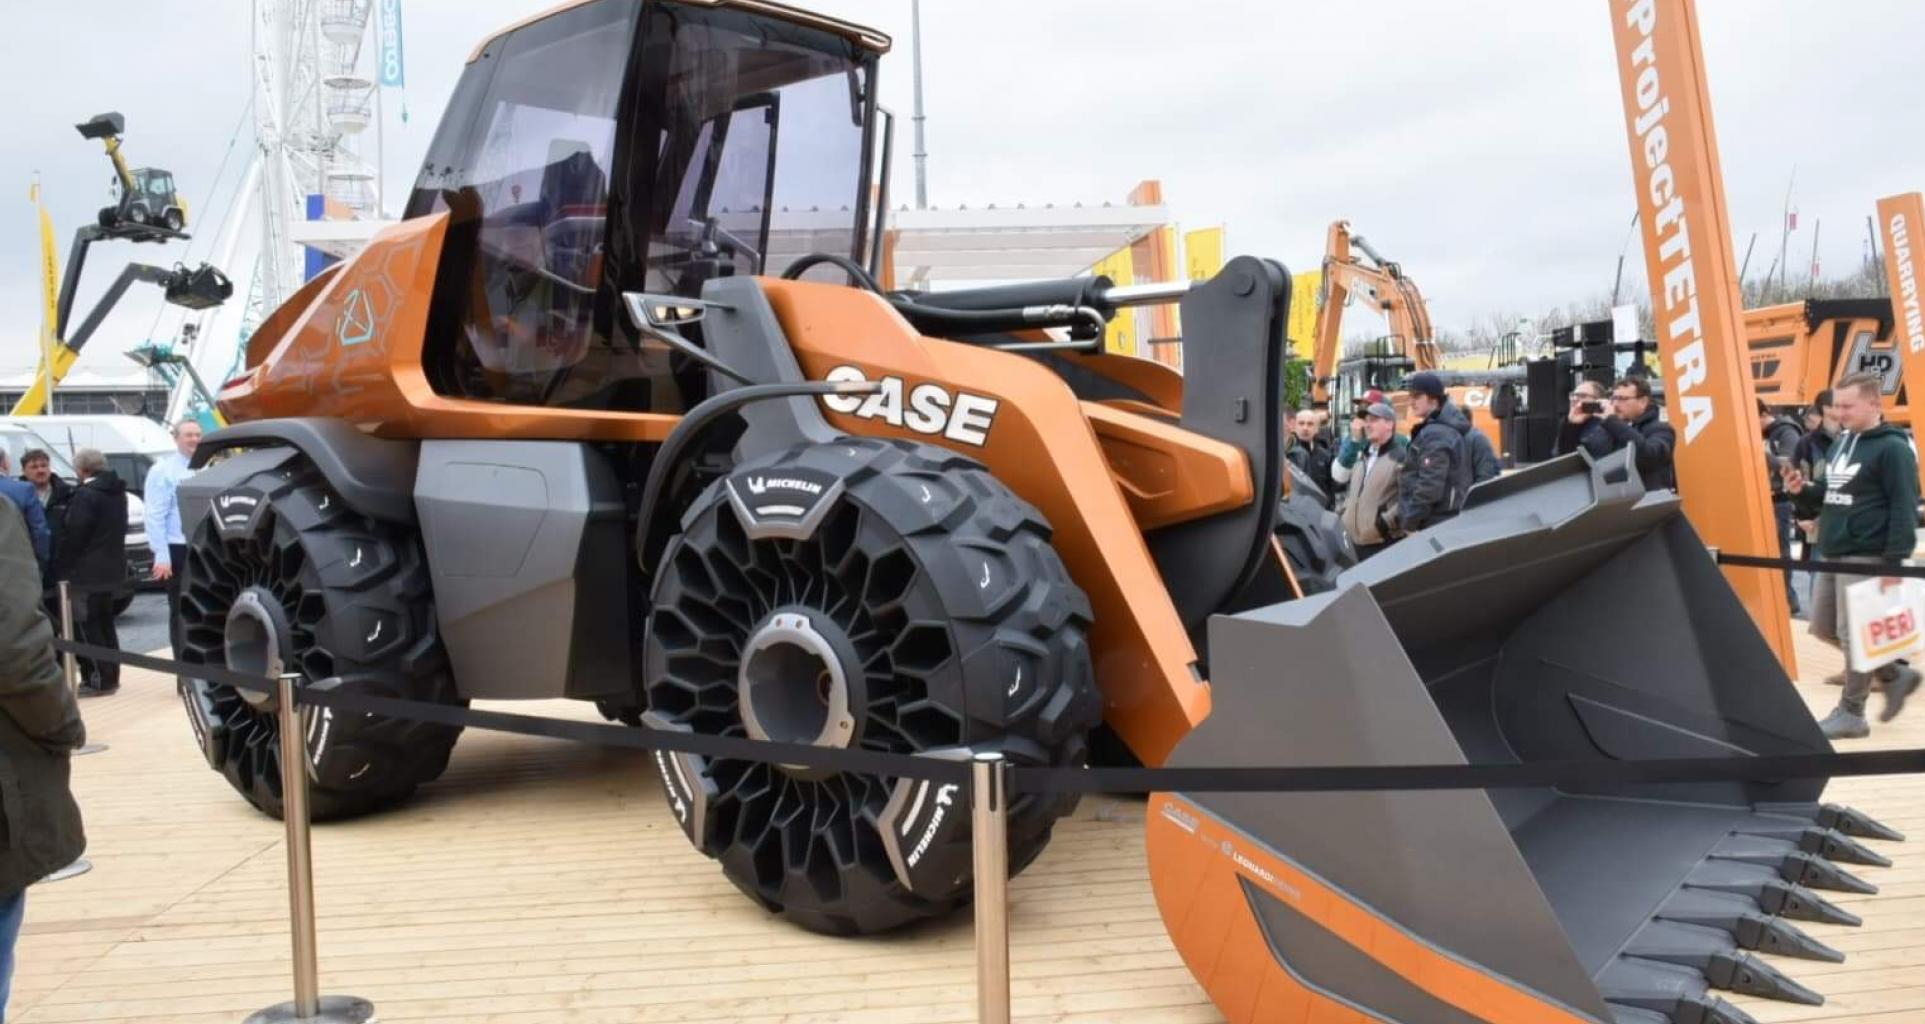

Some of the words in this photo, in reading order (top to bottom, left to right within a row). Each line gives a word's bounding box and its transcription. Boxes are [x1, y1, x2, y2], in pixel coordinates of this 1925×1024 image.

[1625, 0, 1714, 446] ProjectTETRA
[1890, 213, 1925, 354] QUARRYING
[1859, 354, 1893, 373] HD
[822, 365, 998, 446] CASE
[766, 478, 822, 495] MICHELIN
[907, 805, 944, 868] MICHELIN
